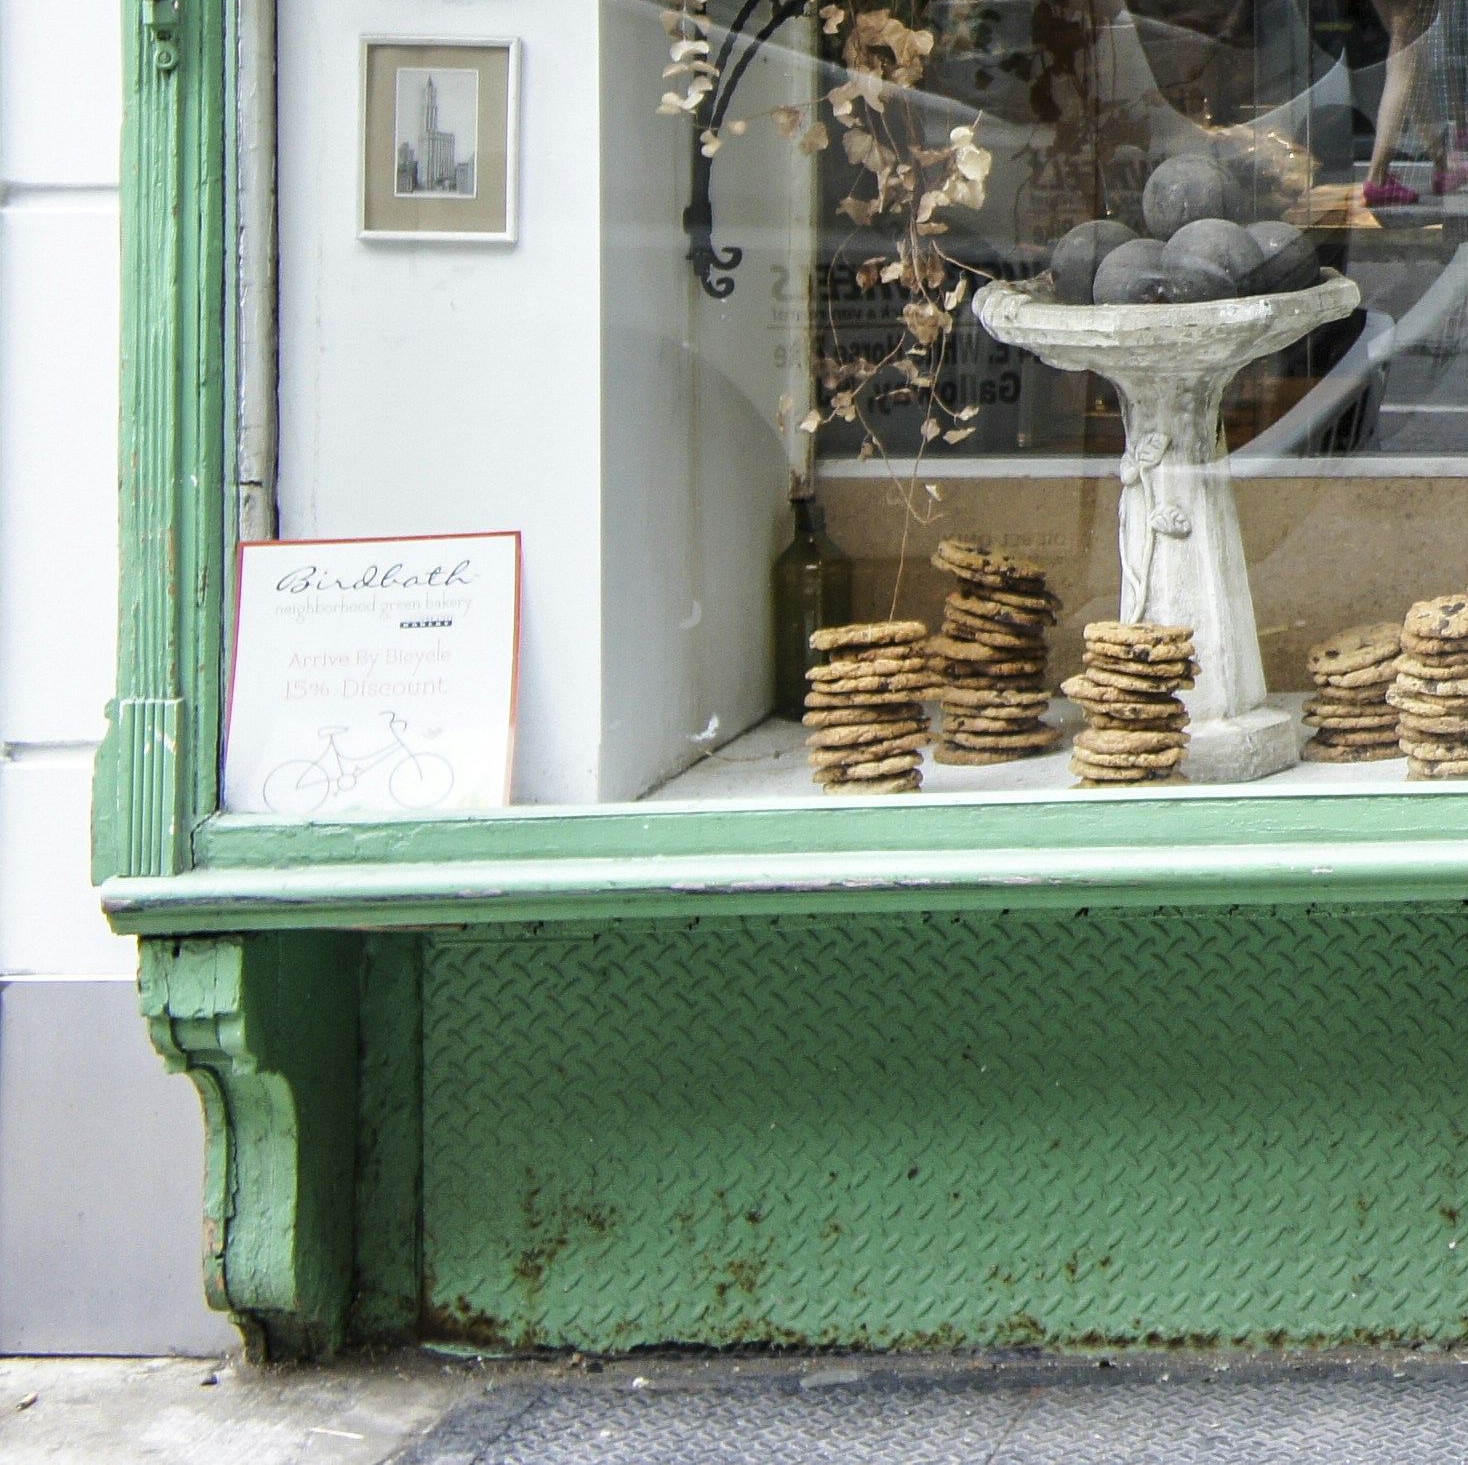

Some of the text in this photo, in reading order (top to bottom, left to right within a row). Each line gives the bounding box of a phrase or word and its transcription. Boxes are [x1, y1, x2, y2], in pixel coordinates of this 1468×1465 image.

[275, 559, 473, 594] Birdbath
[275, 592, 473, 624] neighborhood green bakery
[287, 638, 453, 678] Arrive By Bicycle
[285, 677, 448, 701] 15% Discount
